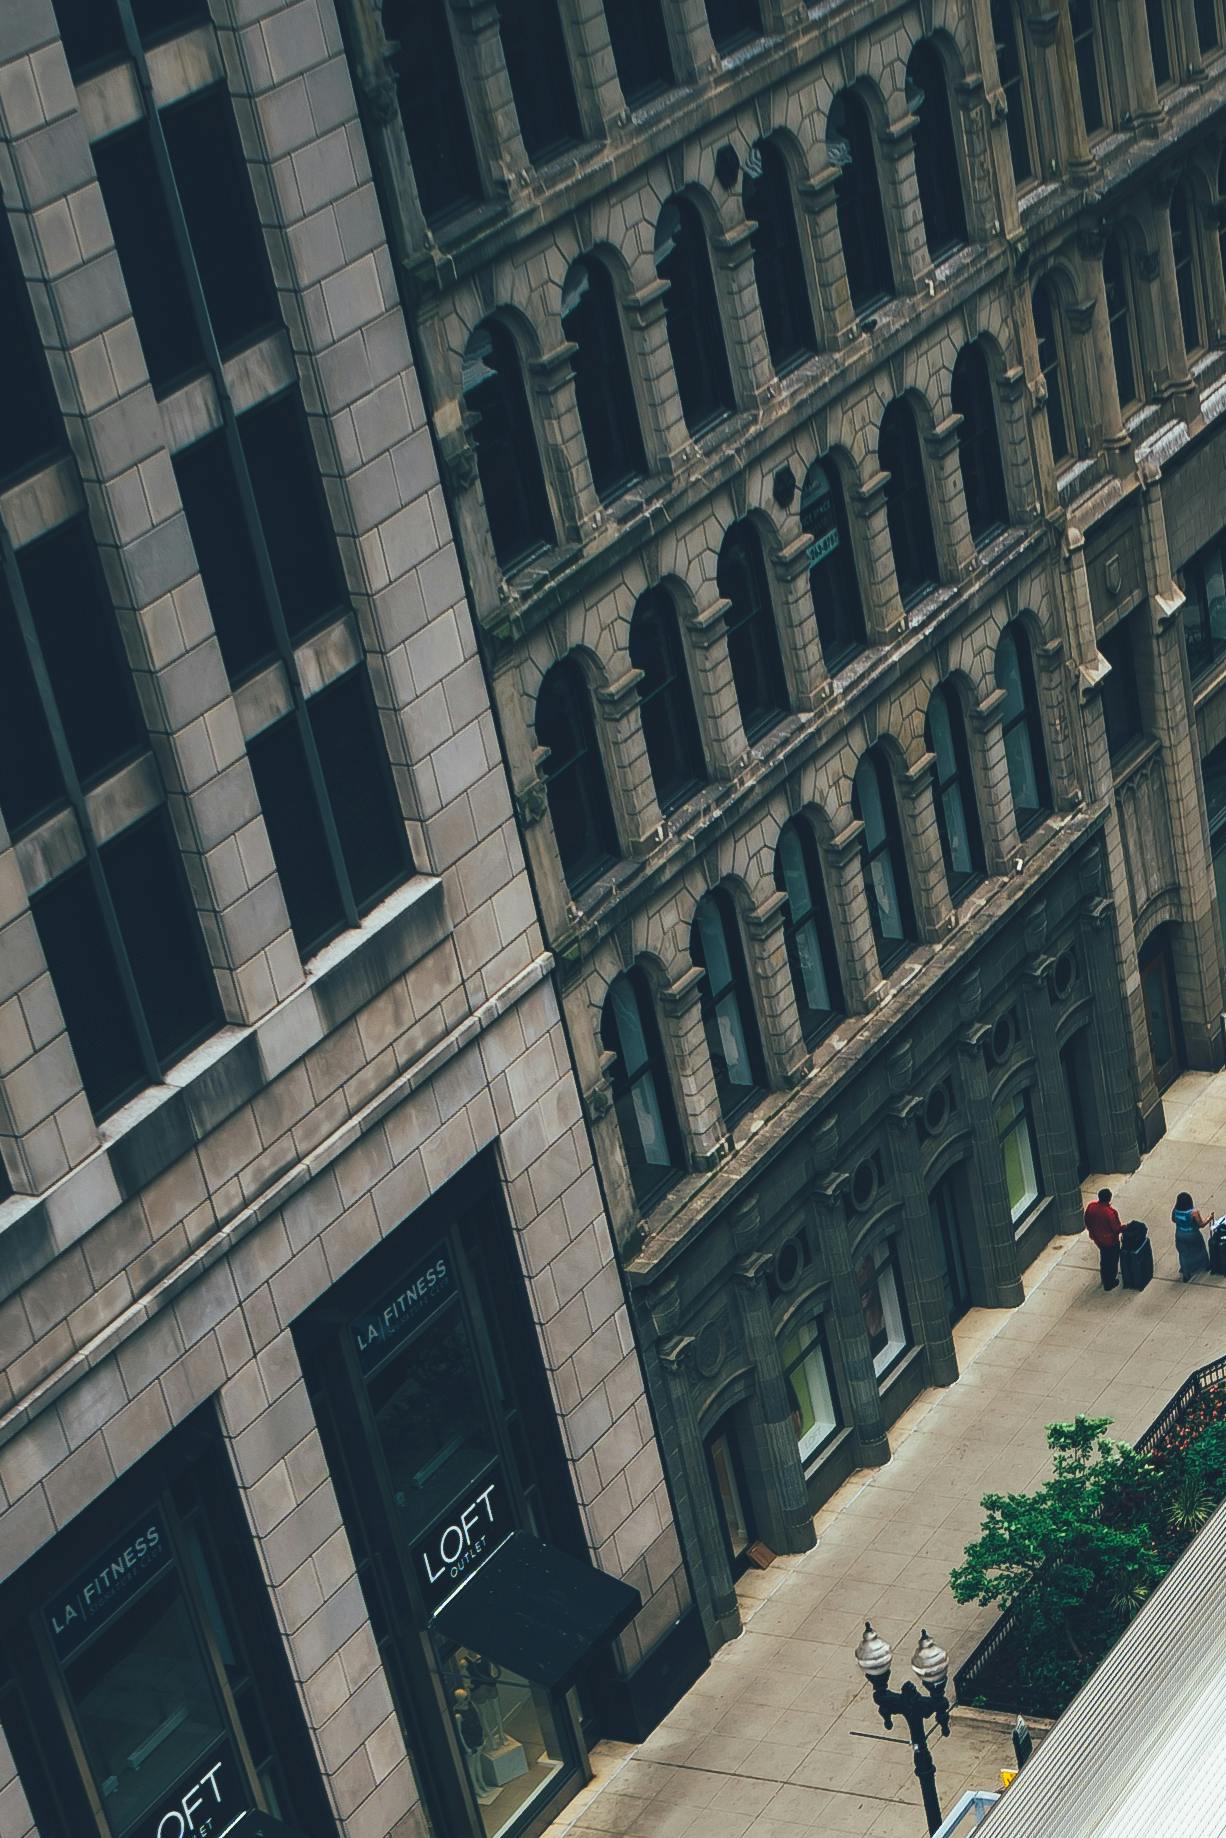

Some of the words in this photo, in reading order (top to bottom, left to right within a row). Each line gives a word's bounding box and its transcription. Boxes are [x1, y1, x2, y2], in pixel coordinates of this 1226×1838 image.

[357, 1324, 379, 1351] LA
[383, 1259, 447, 1327] FITNESS
[51, 1604, 78, 1634] LA
[83, 1526, 159, 1605] FITNESS
[423, 1484, 495, 1583] LOFT
[450, 1535, 486, 1578] OUTLET
